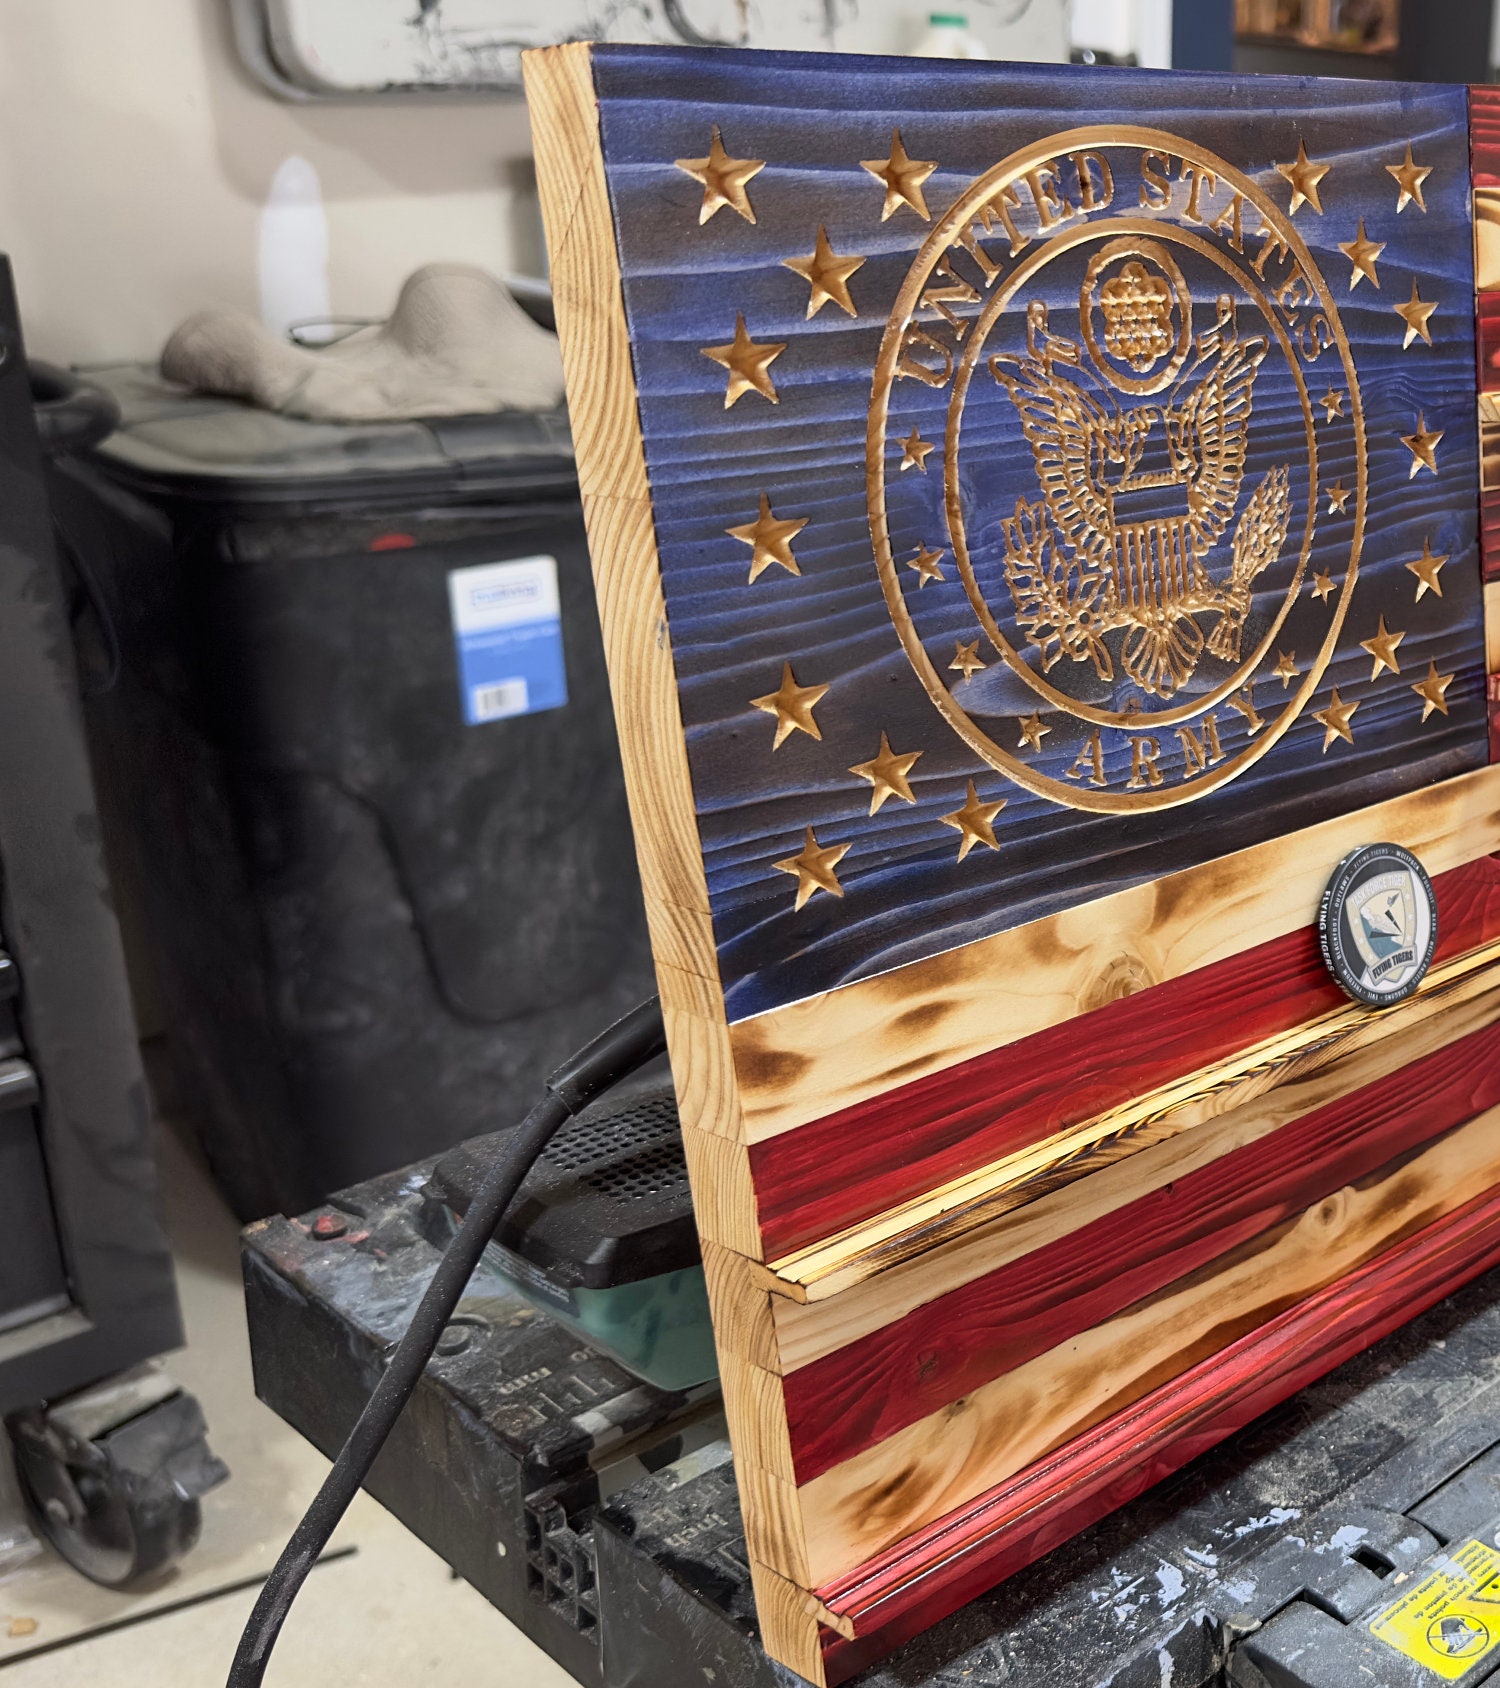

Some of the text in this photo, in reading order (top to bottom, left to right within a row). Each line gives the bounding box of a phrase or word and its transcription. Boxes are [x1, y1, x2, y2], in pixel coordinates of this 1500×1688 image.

[893, 150, 1336, 389] UNITED STATES
[1067, 679, 1267, 788] ARMY
[1367, 879, 1388, 898] FORCE
[1388, 875, 1407, 888] TIGER
[1320, 890, 1335, 972] FLYING TIGERS
[1371, 949, 1414, 980] FLYING TIGERS
